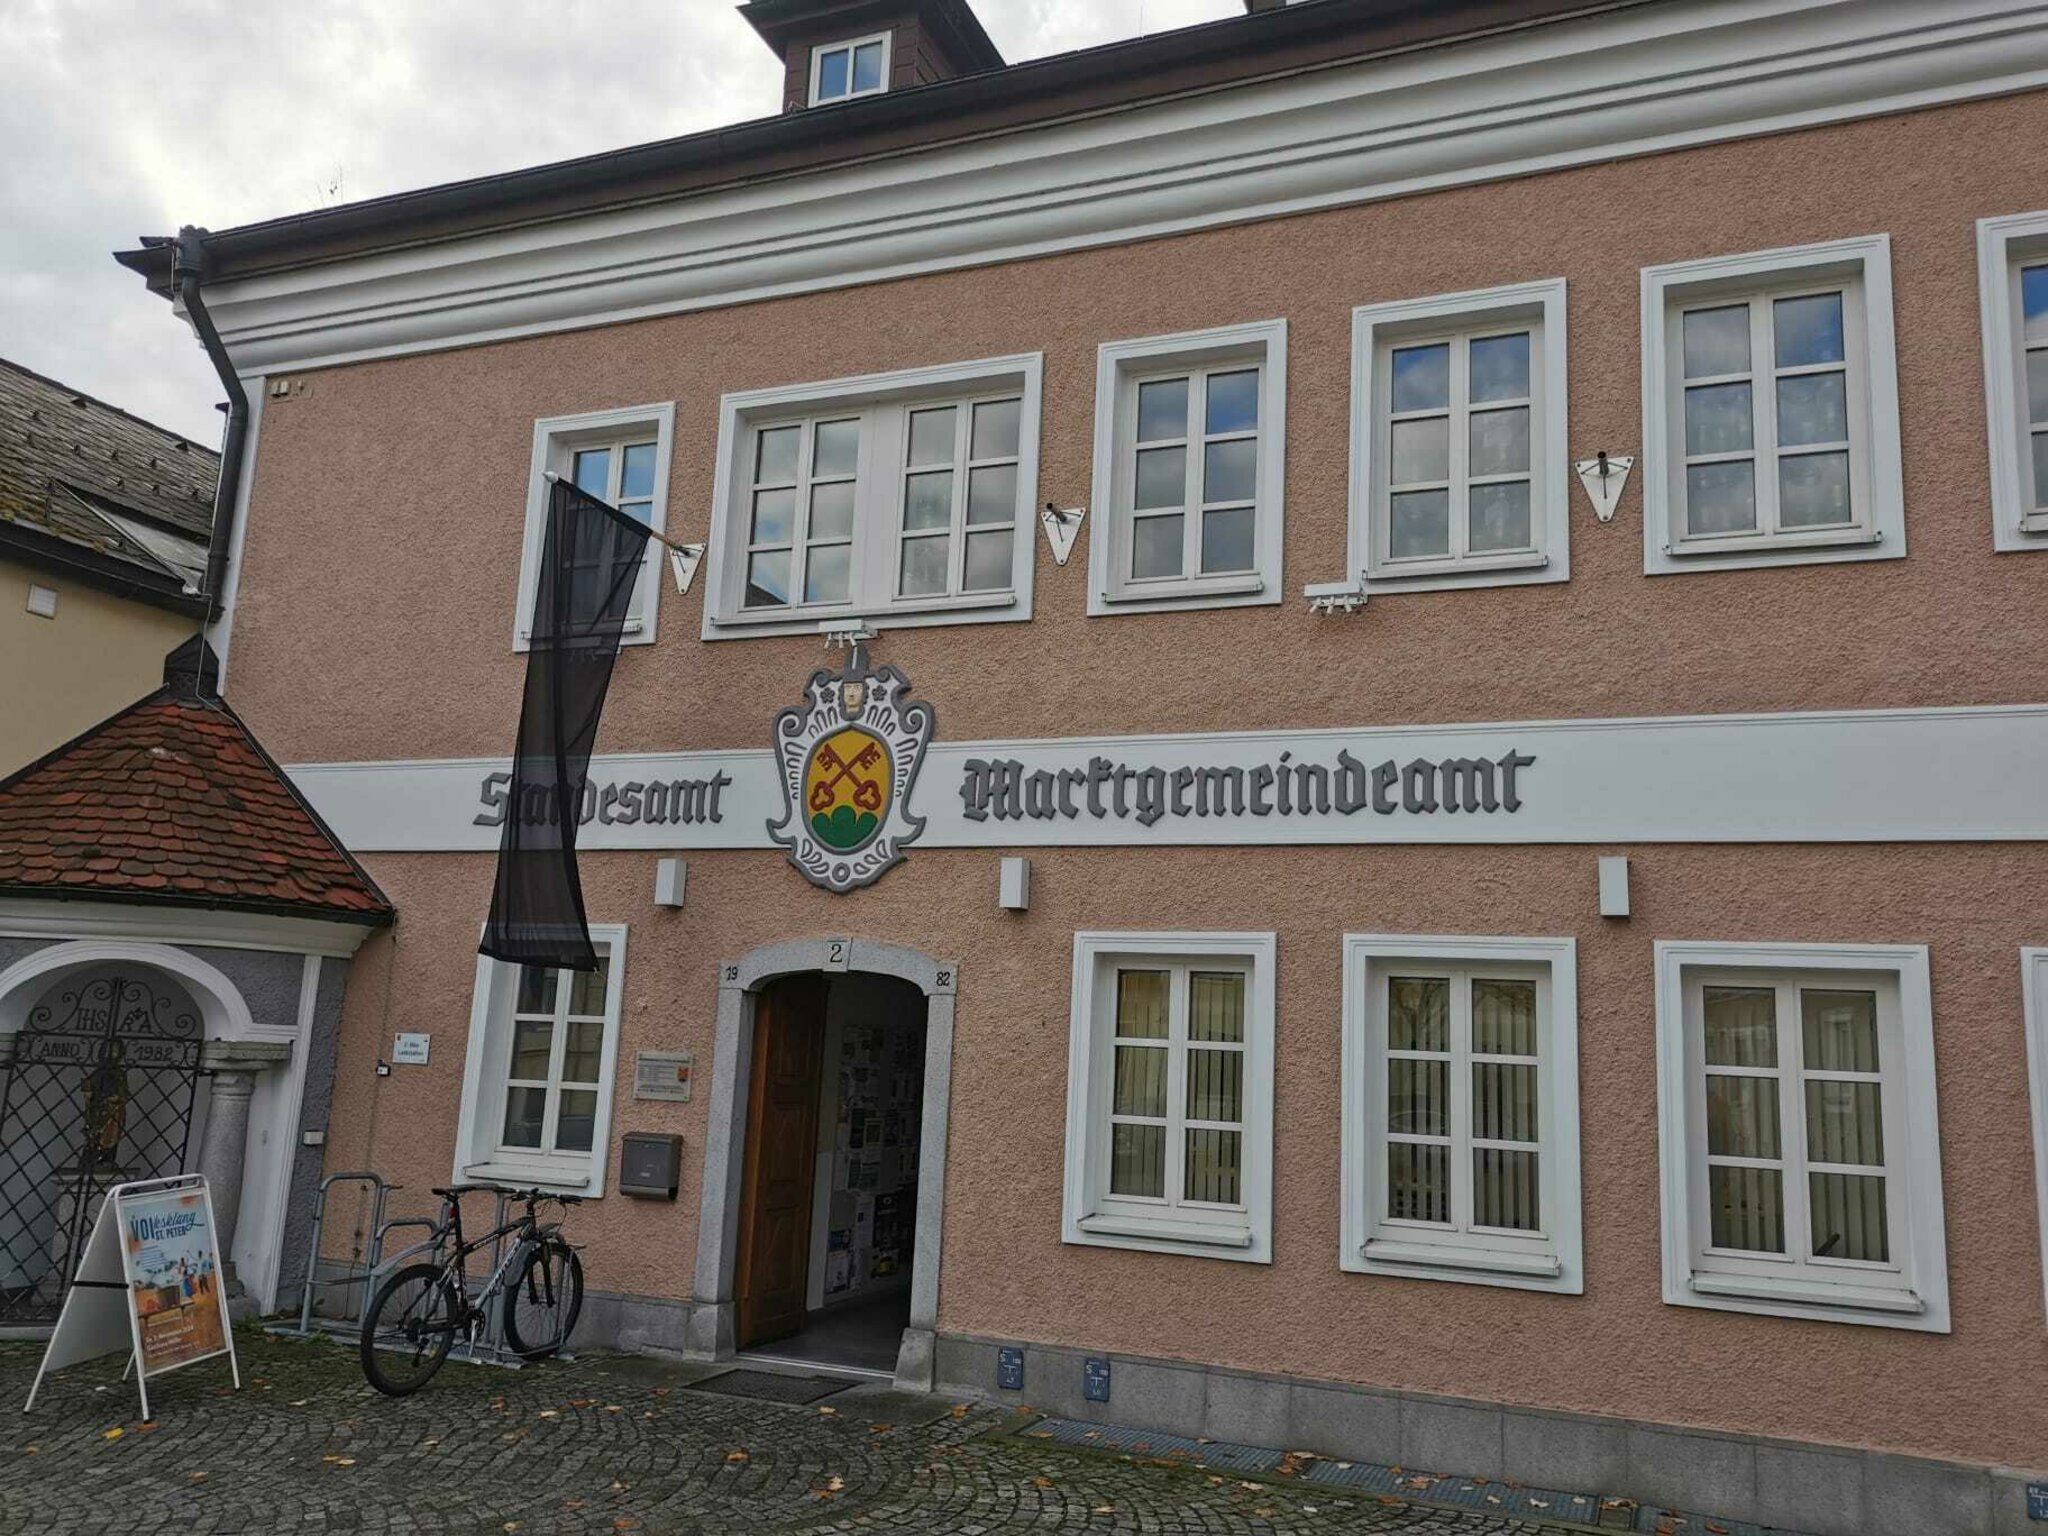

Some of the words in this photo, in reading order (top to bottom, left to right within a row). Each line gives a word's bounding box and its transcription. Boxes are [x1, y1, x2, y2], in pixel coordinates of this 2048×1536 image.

[959, 748, 1536, 828] Marktgemeindeamt
[829, 943, 844, 963] 2
[726, 966, 739, 981] 19
[936, 971, 951, 987] 82
[75, 1007, 108, 1032] IHS
[40, 1042, 80, 1057] ANNO
[134, 1045, 174, 1061] 1982
